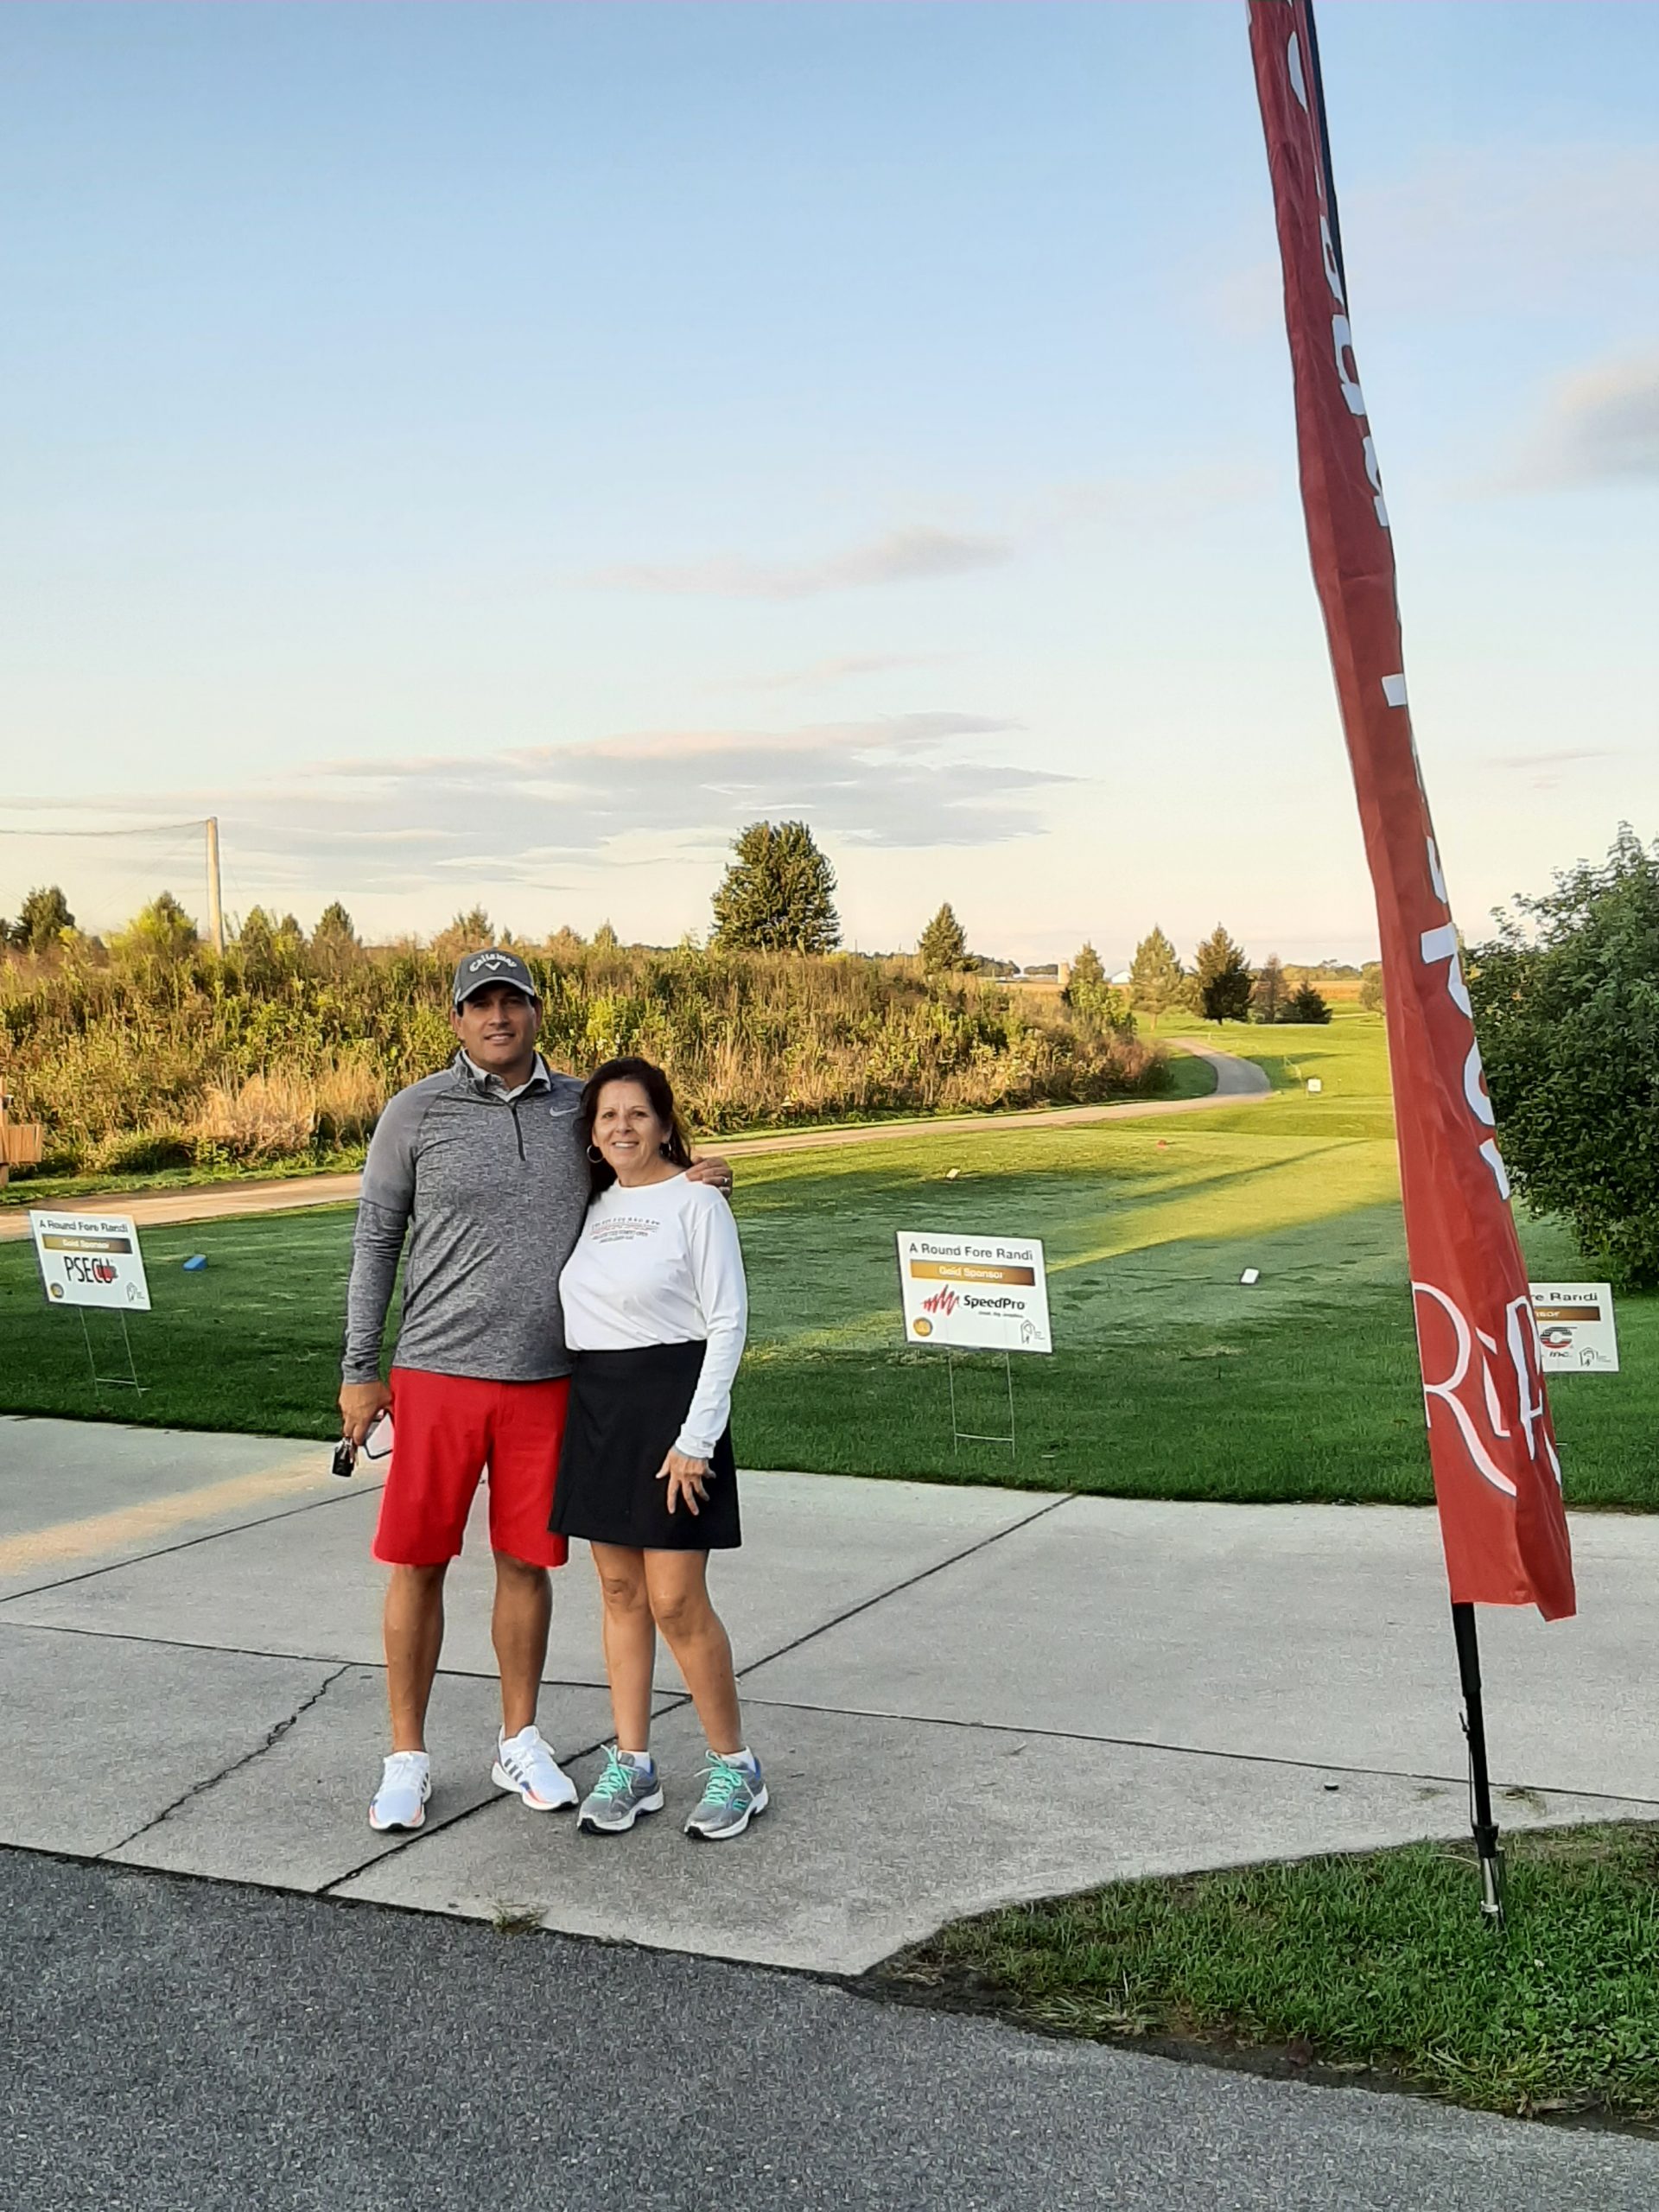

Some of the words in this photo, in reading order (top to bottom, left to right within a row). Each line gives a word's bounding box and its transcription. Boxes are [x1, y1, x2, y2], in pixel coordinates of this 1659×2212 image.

[469, 954, 518, 972] Callaway
[40, 1219, 47, 1228] A
[48, 1219, 77, 1230] Round
[79, 1221, 99, 1231] Fore
[909, 1243, 918, 1253] A
[921, 1243, 962, 1256] Round
[964, 1246, 993, 1258] Fore
[996, 1248, 1033, 1261] Randi
[64, 1255, 114, 1284] PSECU
[939, 1265, 962, 1277] Gold
[964, 1267, 1003, 1280] Sponsor
[963, 1294, 1026, 1310] SpeedPro
[1549, 1292, 1598, 1301] Randi
